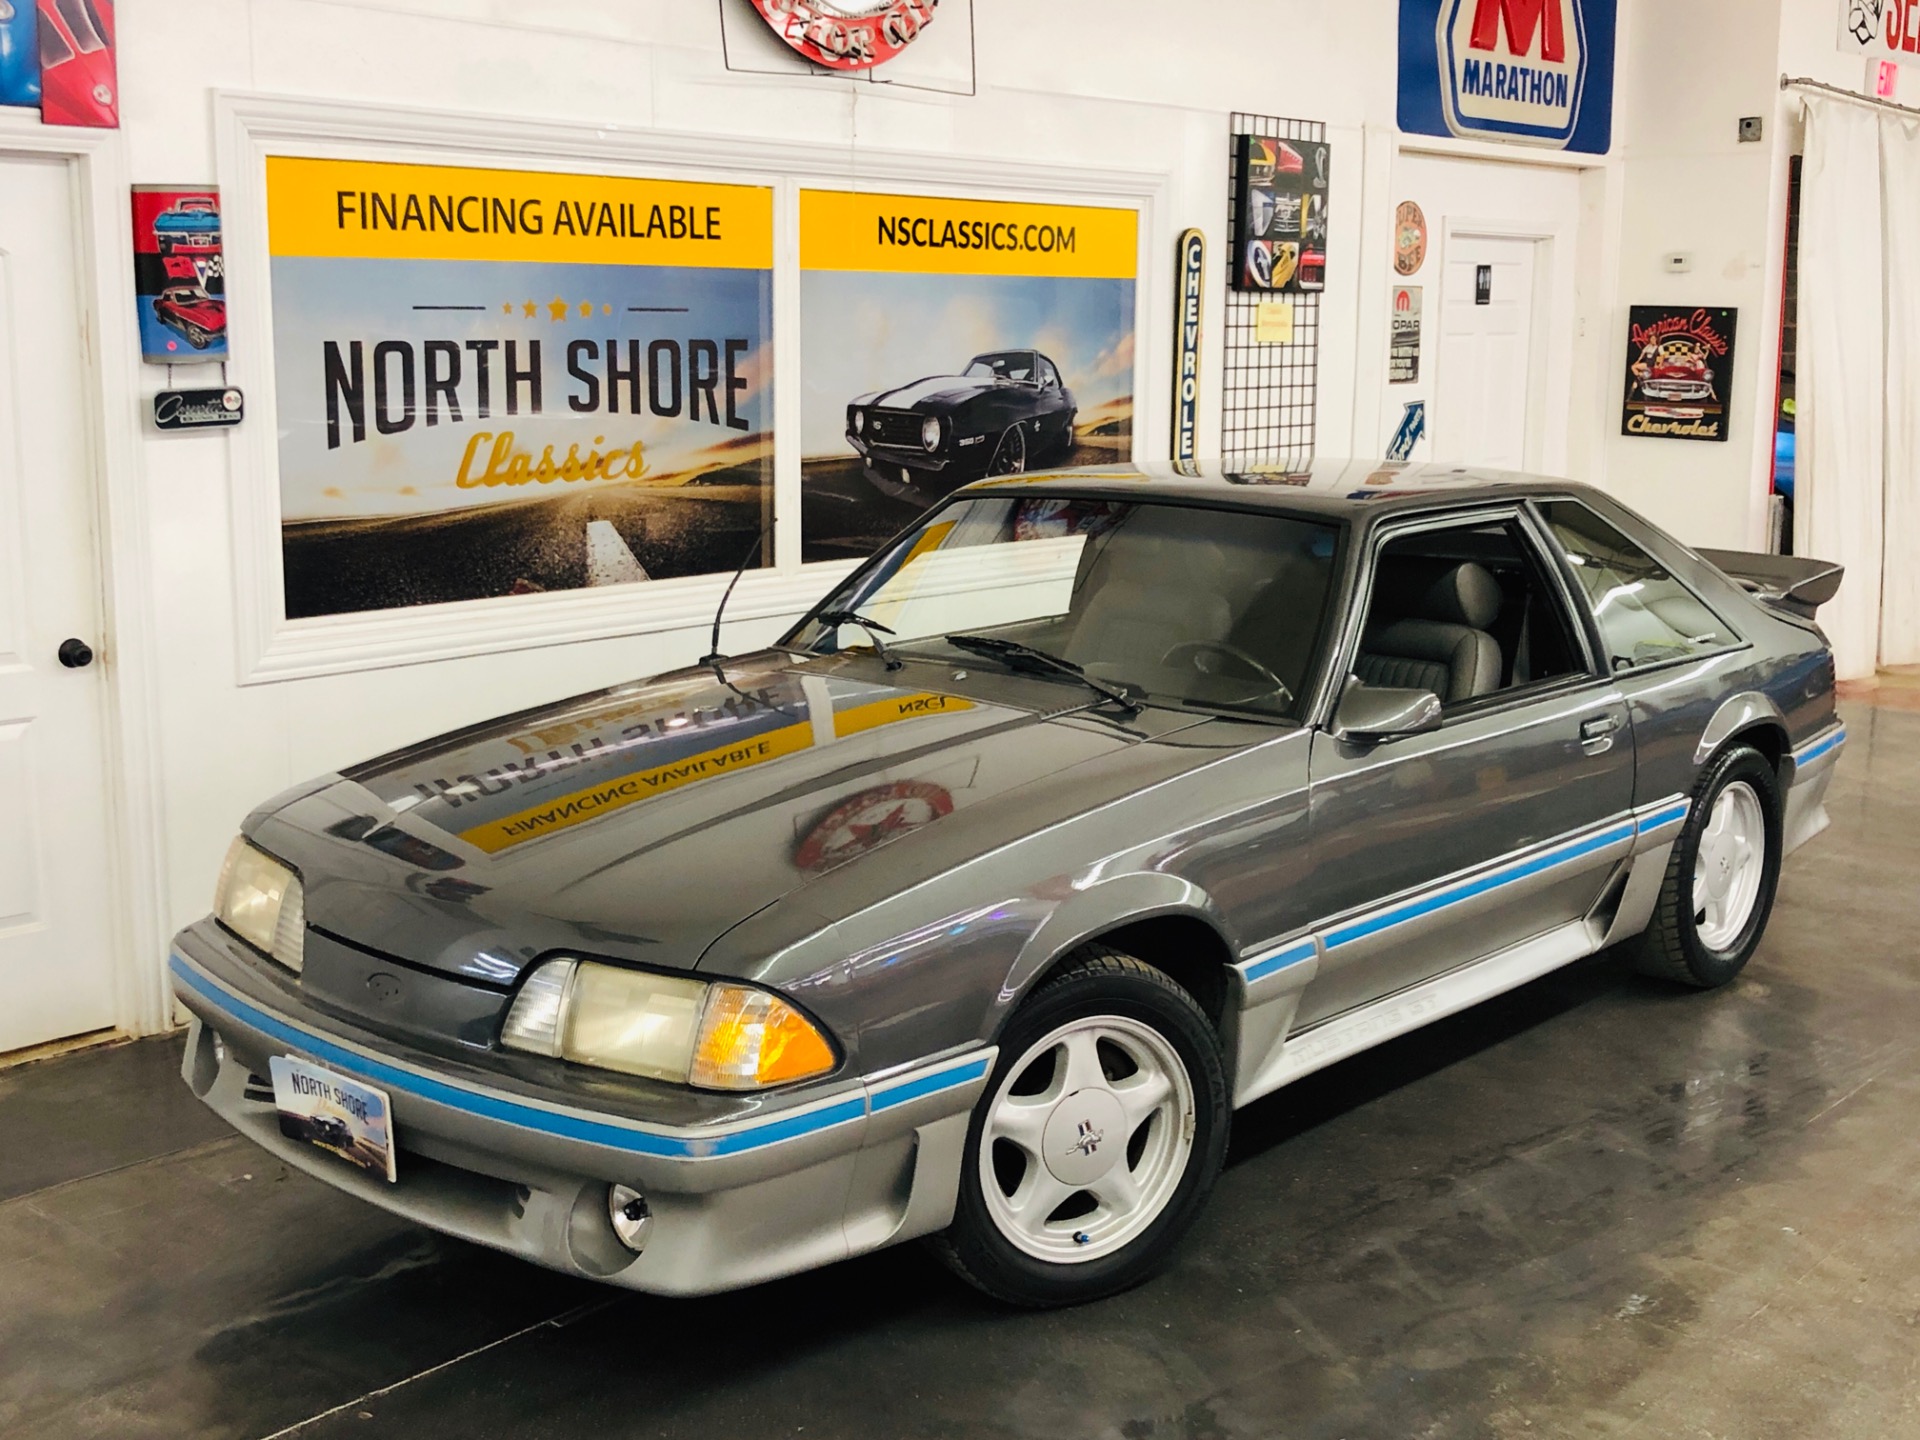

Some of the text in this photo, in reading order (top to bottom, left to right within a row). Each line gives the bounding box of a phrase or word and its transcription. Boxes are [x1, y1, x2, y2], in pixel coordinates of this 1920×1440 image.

[1886, 0, 1920, 54] SE
[1462, 58, 1568, 108] MARATHON
[336, 190, 722, 241] FINANCING AVAILABLE
[878, 215, 1077, 254] NSCLASSICS.COM
[1181, 244, 1202, 456] CHEVROLE
[1392, 319, 1420, 331] OPAR
[323, 338, 750, 451] NORTH SHORE
[1627, 414, 1719, 437] Chevrolet
[455, 430, 651, 489] Classics
[291, 1072, 332, 1101] NORTH
[334, 1087, 369, 1125] SHORE
